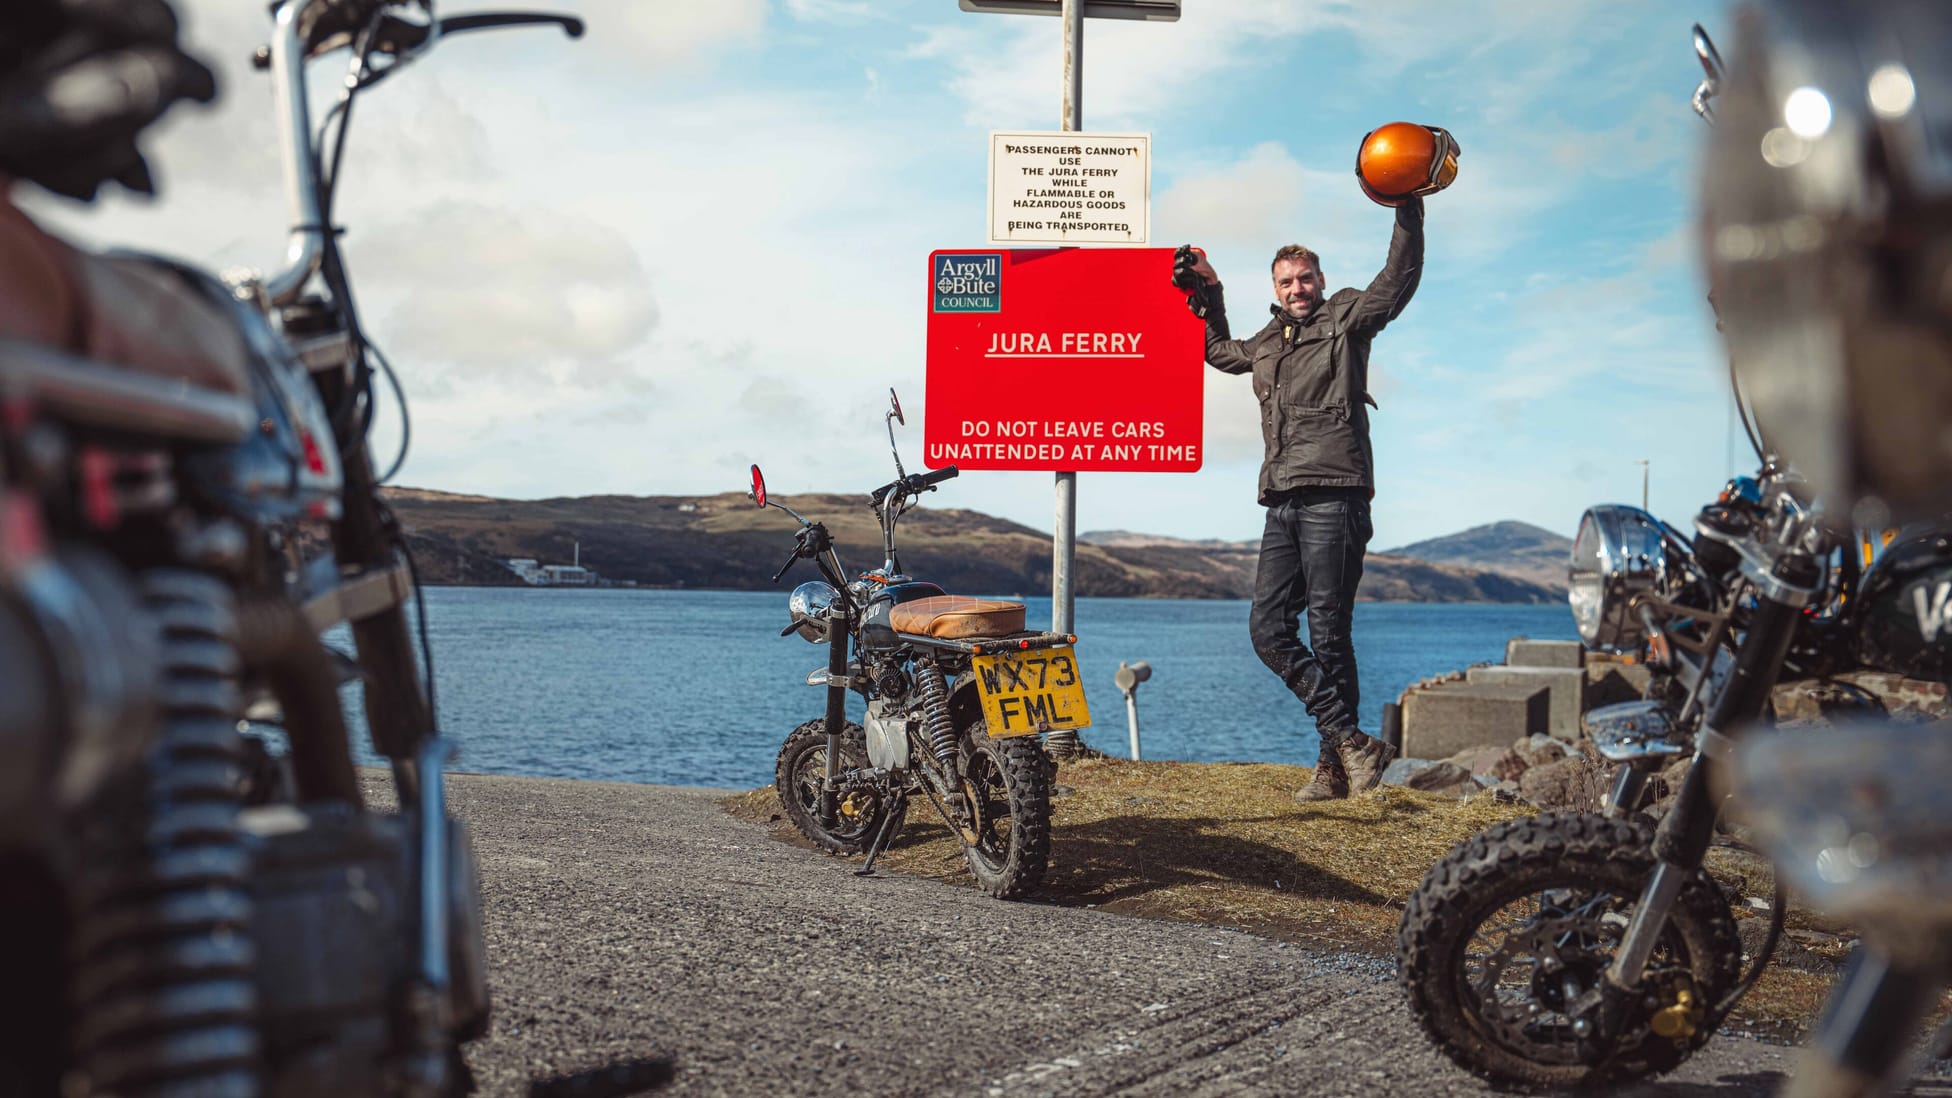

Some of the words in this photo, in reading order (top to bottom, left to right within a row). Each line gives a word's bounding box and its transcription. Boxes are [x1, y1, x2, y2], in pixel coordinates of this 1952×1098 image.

[1008, 145, 1082, 155] PASSENGERS
[1085, 147, 1133, 156] CANNOT
[1059, 157, 1081, 166] USE
[1022, 167, 1044, 176] THE
[1048, 168, 1078, 177] JURA
[1082, 168, 1118, 177] FERRY
[1052, 179, 1088, 187] WHILE
[1026, 189, 1095, 198] FLAMMABLE
[1098, 190, 1115, 199] OR
[1013, 200, 1083, 209] HAZARDOUS
[1086, 201, 1126, 210] GOODS
[1059, 211, 1082, 220] ARE
[1008, 221, 1043, 230] BEING
[1046, 221, 1129, 232] TRANSPORTED
[940, 258, 996, 280] Argyll
[953, 277, 996, 294] Bute
[941, 297, 994, 308] COUNCIL
[987, 332, 1052, 353] JURA
[1061, 332, 1143, 353] FERRY
[961, 420, 990, 437] DO
[996, 421, 1038, 437] NOT
[1044, 421, 1104, 438] LEAVE
[1111, 422, 1165, 438] CARS
[930, 443, 1065, 460] UNATTENDED
[1071, 444, 1096, 460] AT
[1100, 444, 1143, 461] ANY
[1148, 445, 1196, 462] TIME
[979, 655, 1075, 694] WX73
[999, 693, 1073, 729] FML
